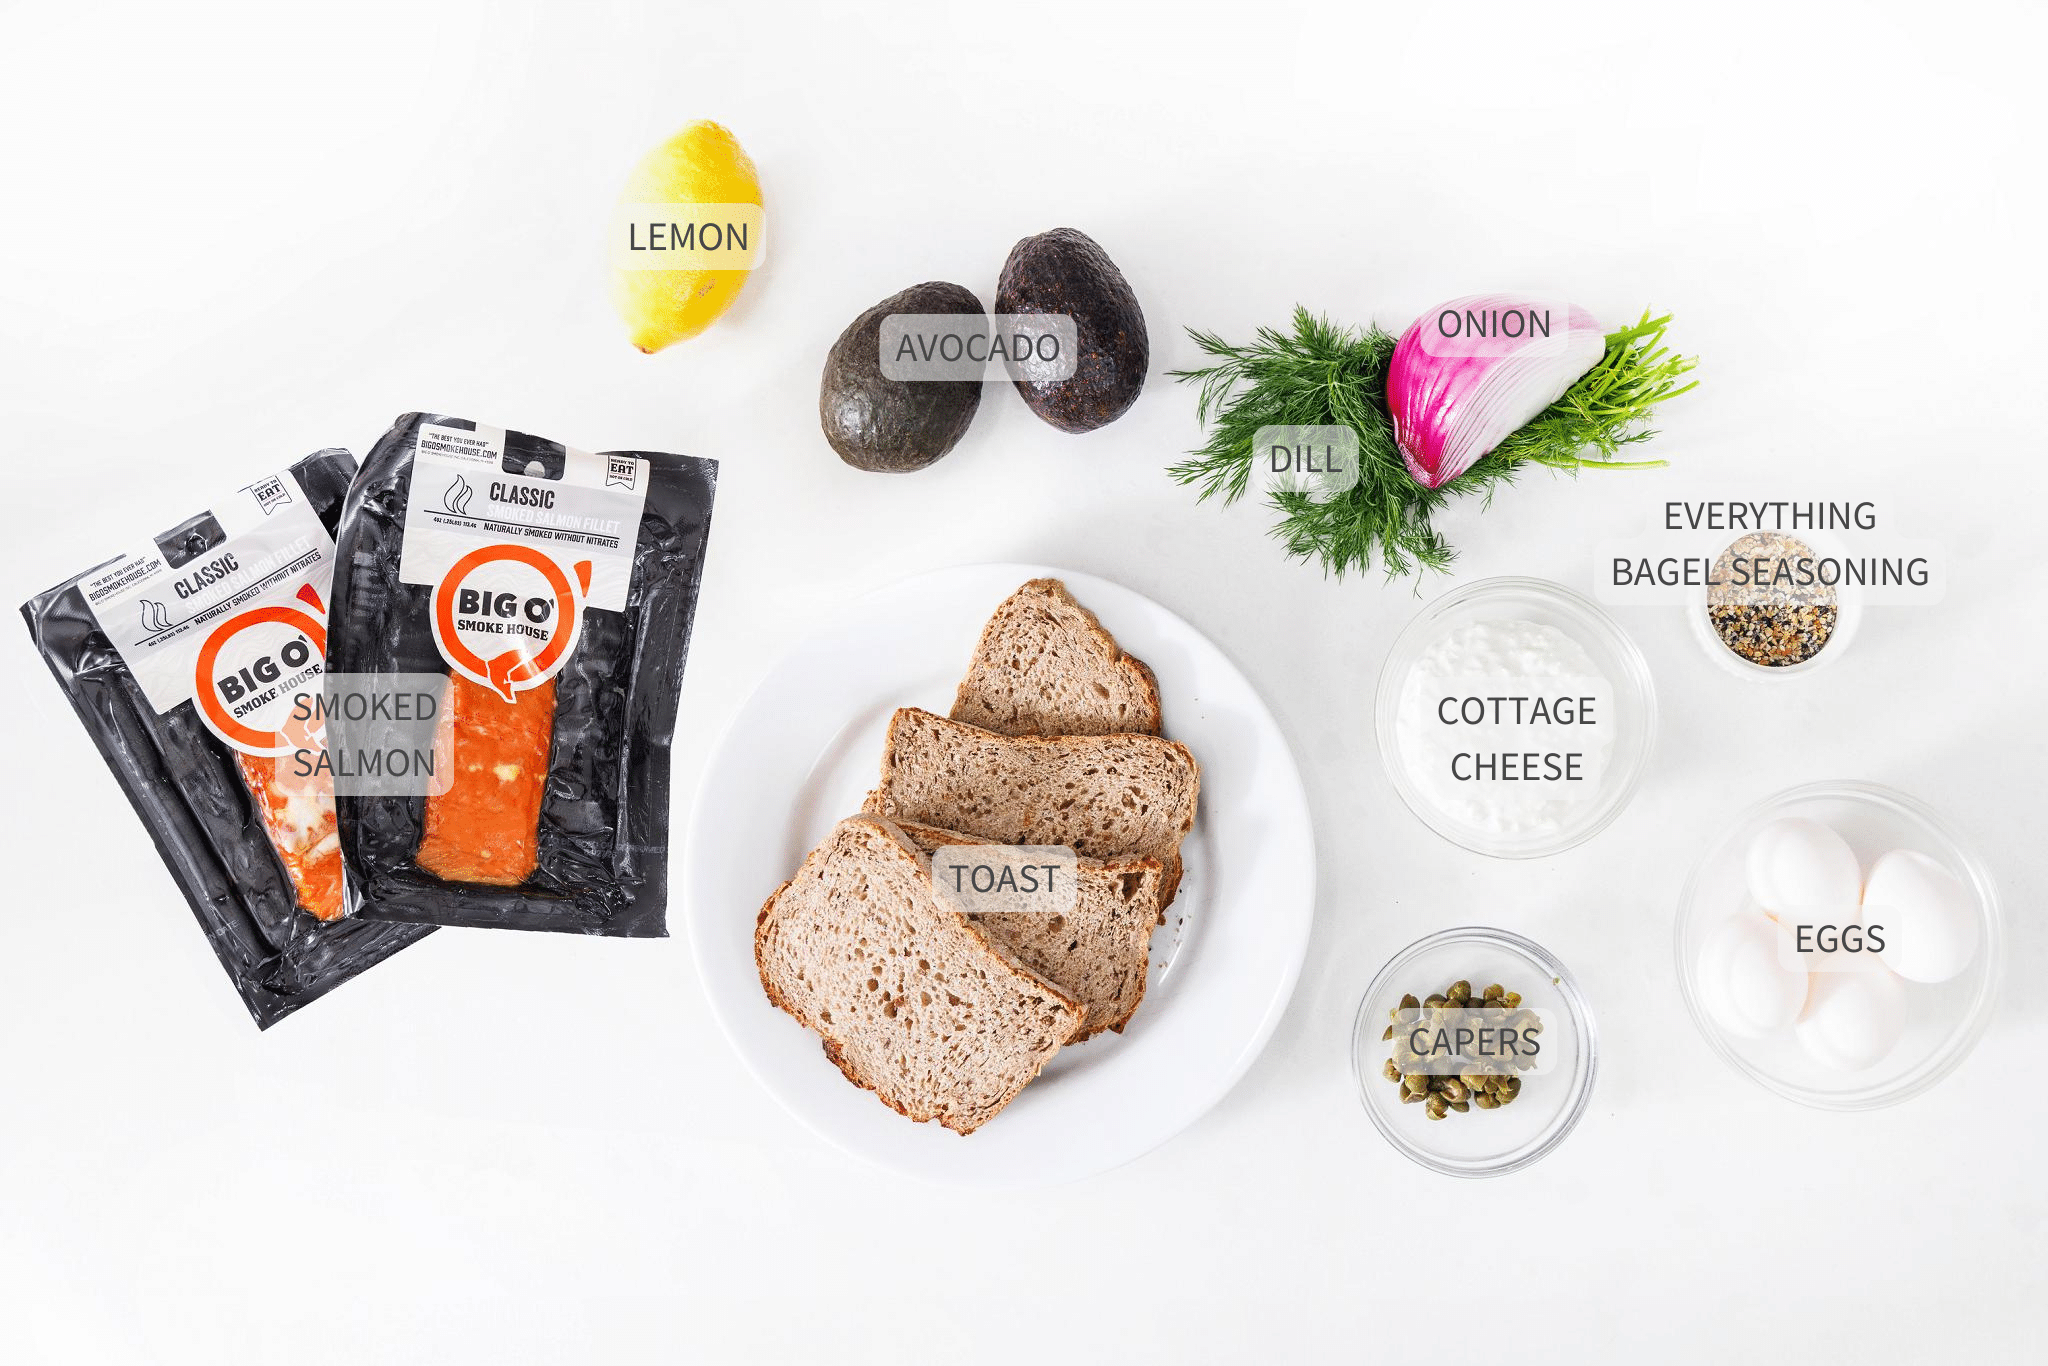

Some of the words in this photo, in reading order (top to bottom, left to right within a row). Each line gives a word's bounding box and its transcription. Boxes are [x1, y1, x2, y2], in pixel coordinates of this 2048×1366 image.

[610, 462, 634, 474] EAT
[257, 483, 281, 501] EAT
[489, 481, 556, 510] CLASSIC
[486, 503, 535, 523] SMOKED
[535, 510, 582, 530] SALMON
[582, 516, 621, 535] FILLET
[483, 522, 523, 536] NATURALLY
[524, 527, 553, 540] SMOKED
[554, 531, 586, 544] WITHOUT
[586, 536, 619, 549] NITRATES
[88, 558, 162, 602] BIGOSMOKEHOUSE.COM
[174, 552, 240, 600] CLASSIC
[193, 601, 232, 626] NATURALLY
[231, 586, 261, 607] SMOKED
[260, 568, 291, 591] WITHOUT
[289, 551, 322, 574] NITRATES
[458, 588, 518, 619] BIG
[457, 619, 504, 634] SMOKE
[506, 622, 549, 642] HOUSE
[217, 655, 282, 704] BIG
[233, 687, 279, 719] SMOKE
[277, 663, 324, 696] HOUSE
